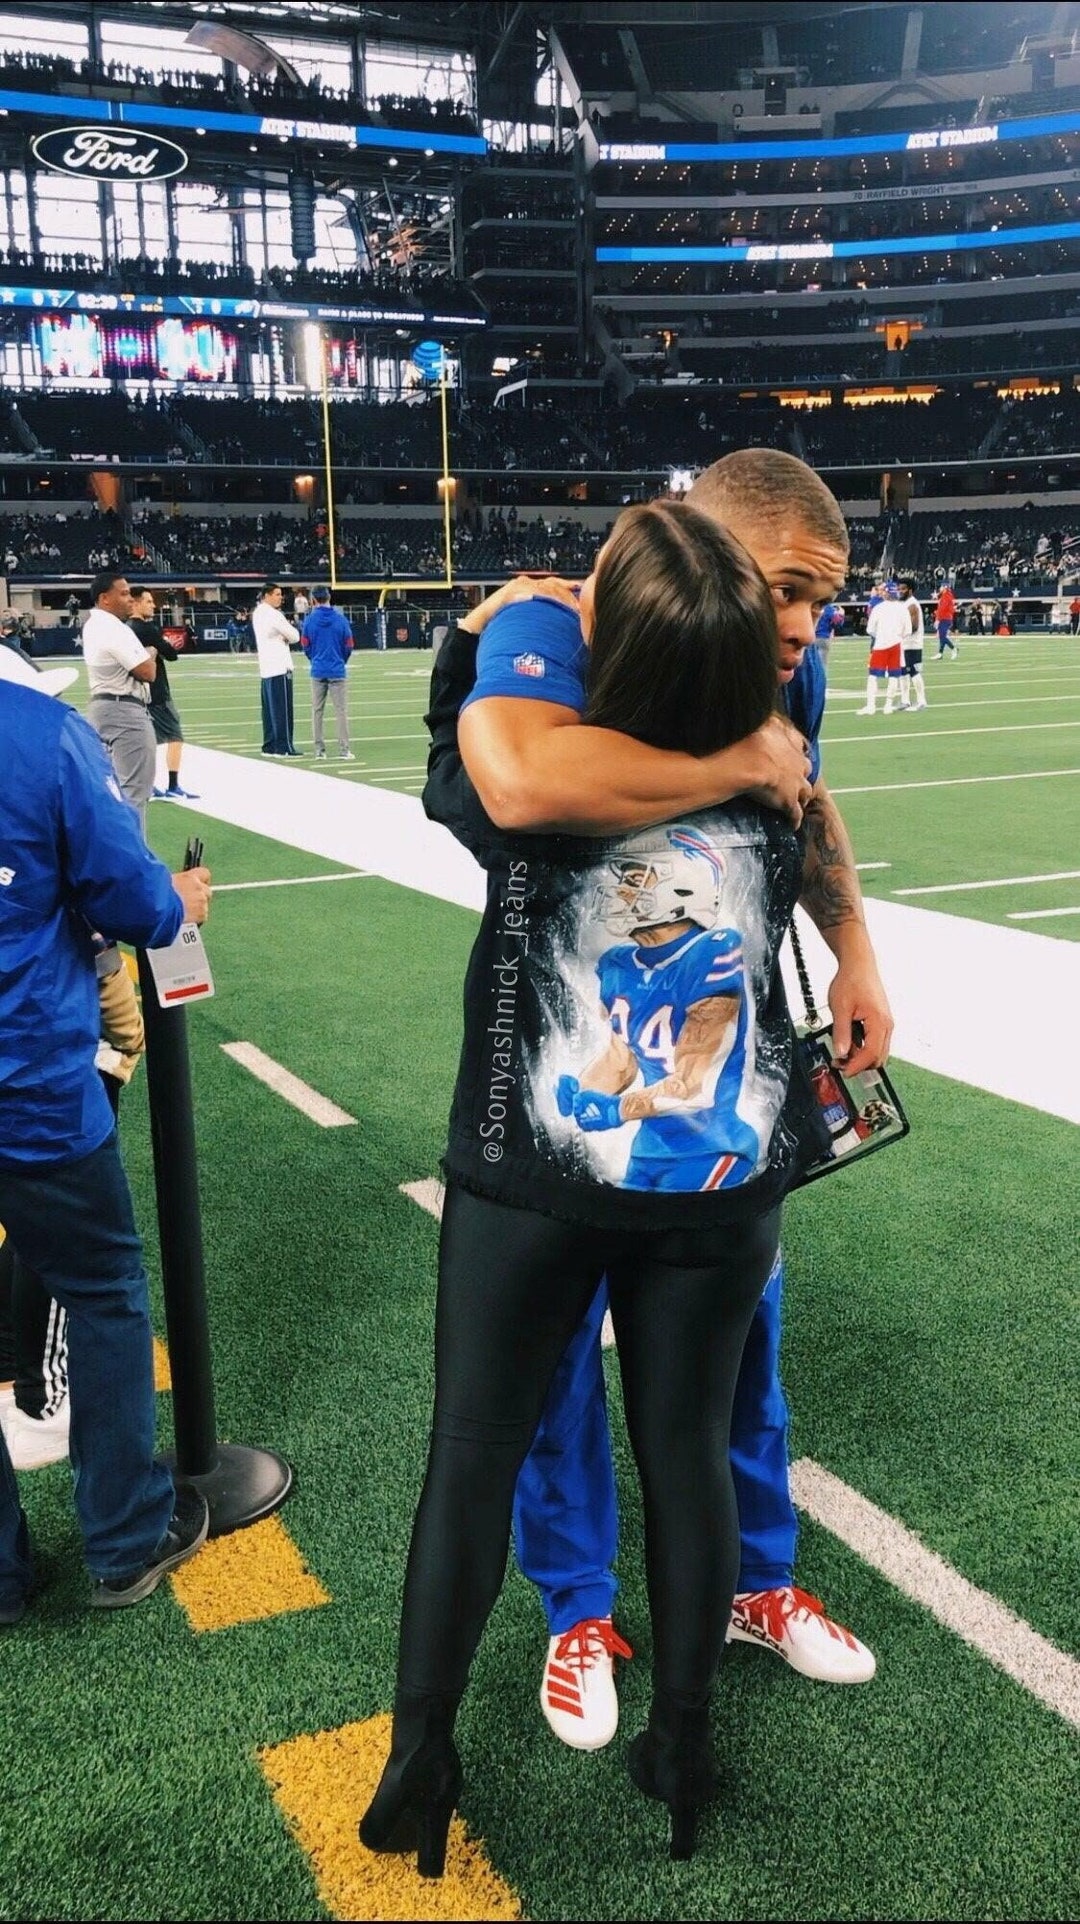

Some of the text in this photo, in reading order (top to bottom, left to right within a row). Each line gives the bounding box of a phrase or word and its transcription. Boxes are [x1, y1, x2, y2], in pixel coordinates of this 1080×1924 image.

[296, 120, 357, 142] STADIUM
[906, 125, 998, 150] AT&T STADIUM
[63, 131, 160, 175] Ford
[610, 144, 666, 160] STADIUM
[866, 188, 908, 199] RAYFIELD
[910, 184, 946, 197] WRIGHT
[778, 243, 834, 260] STADIUM
[182, 930, 198, 944] 08
[732, 1616, 790, 1660] didas
